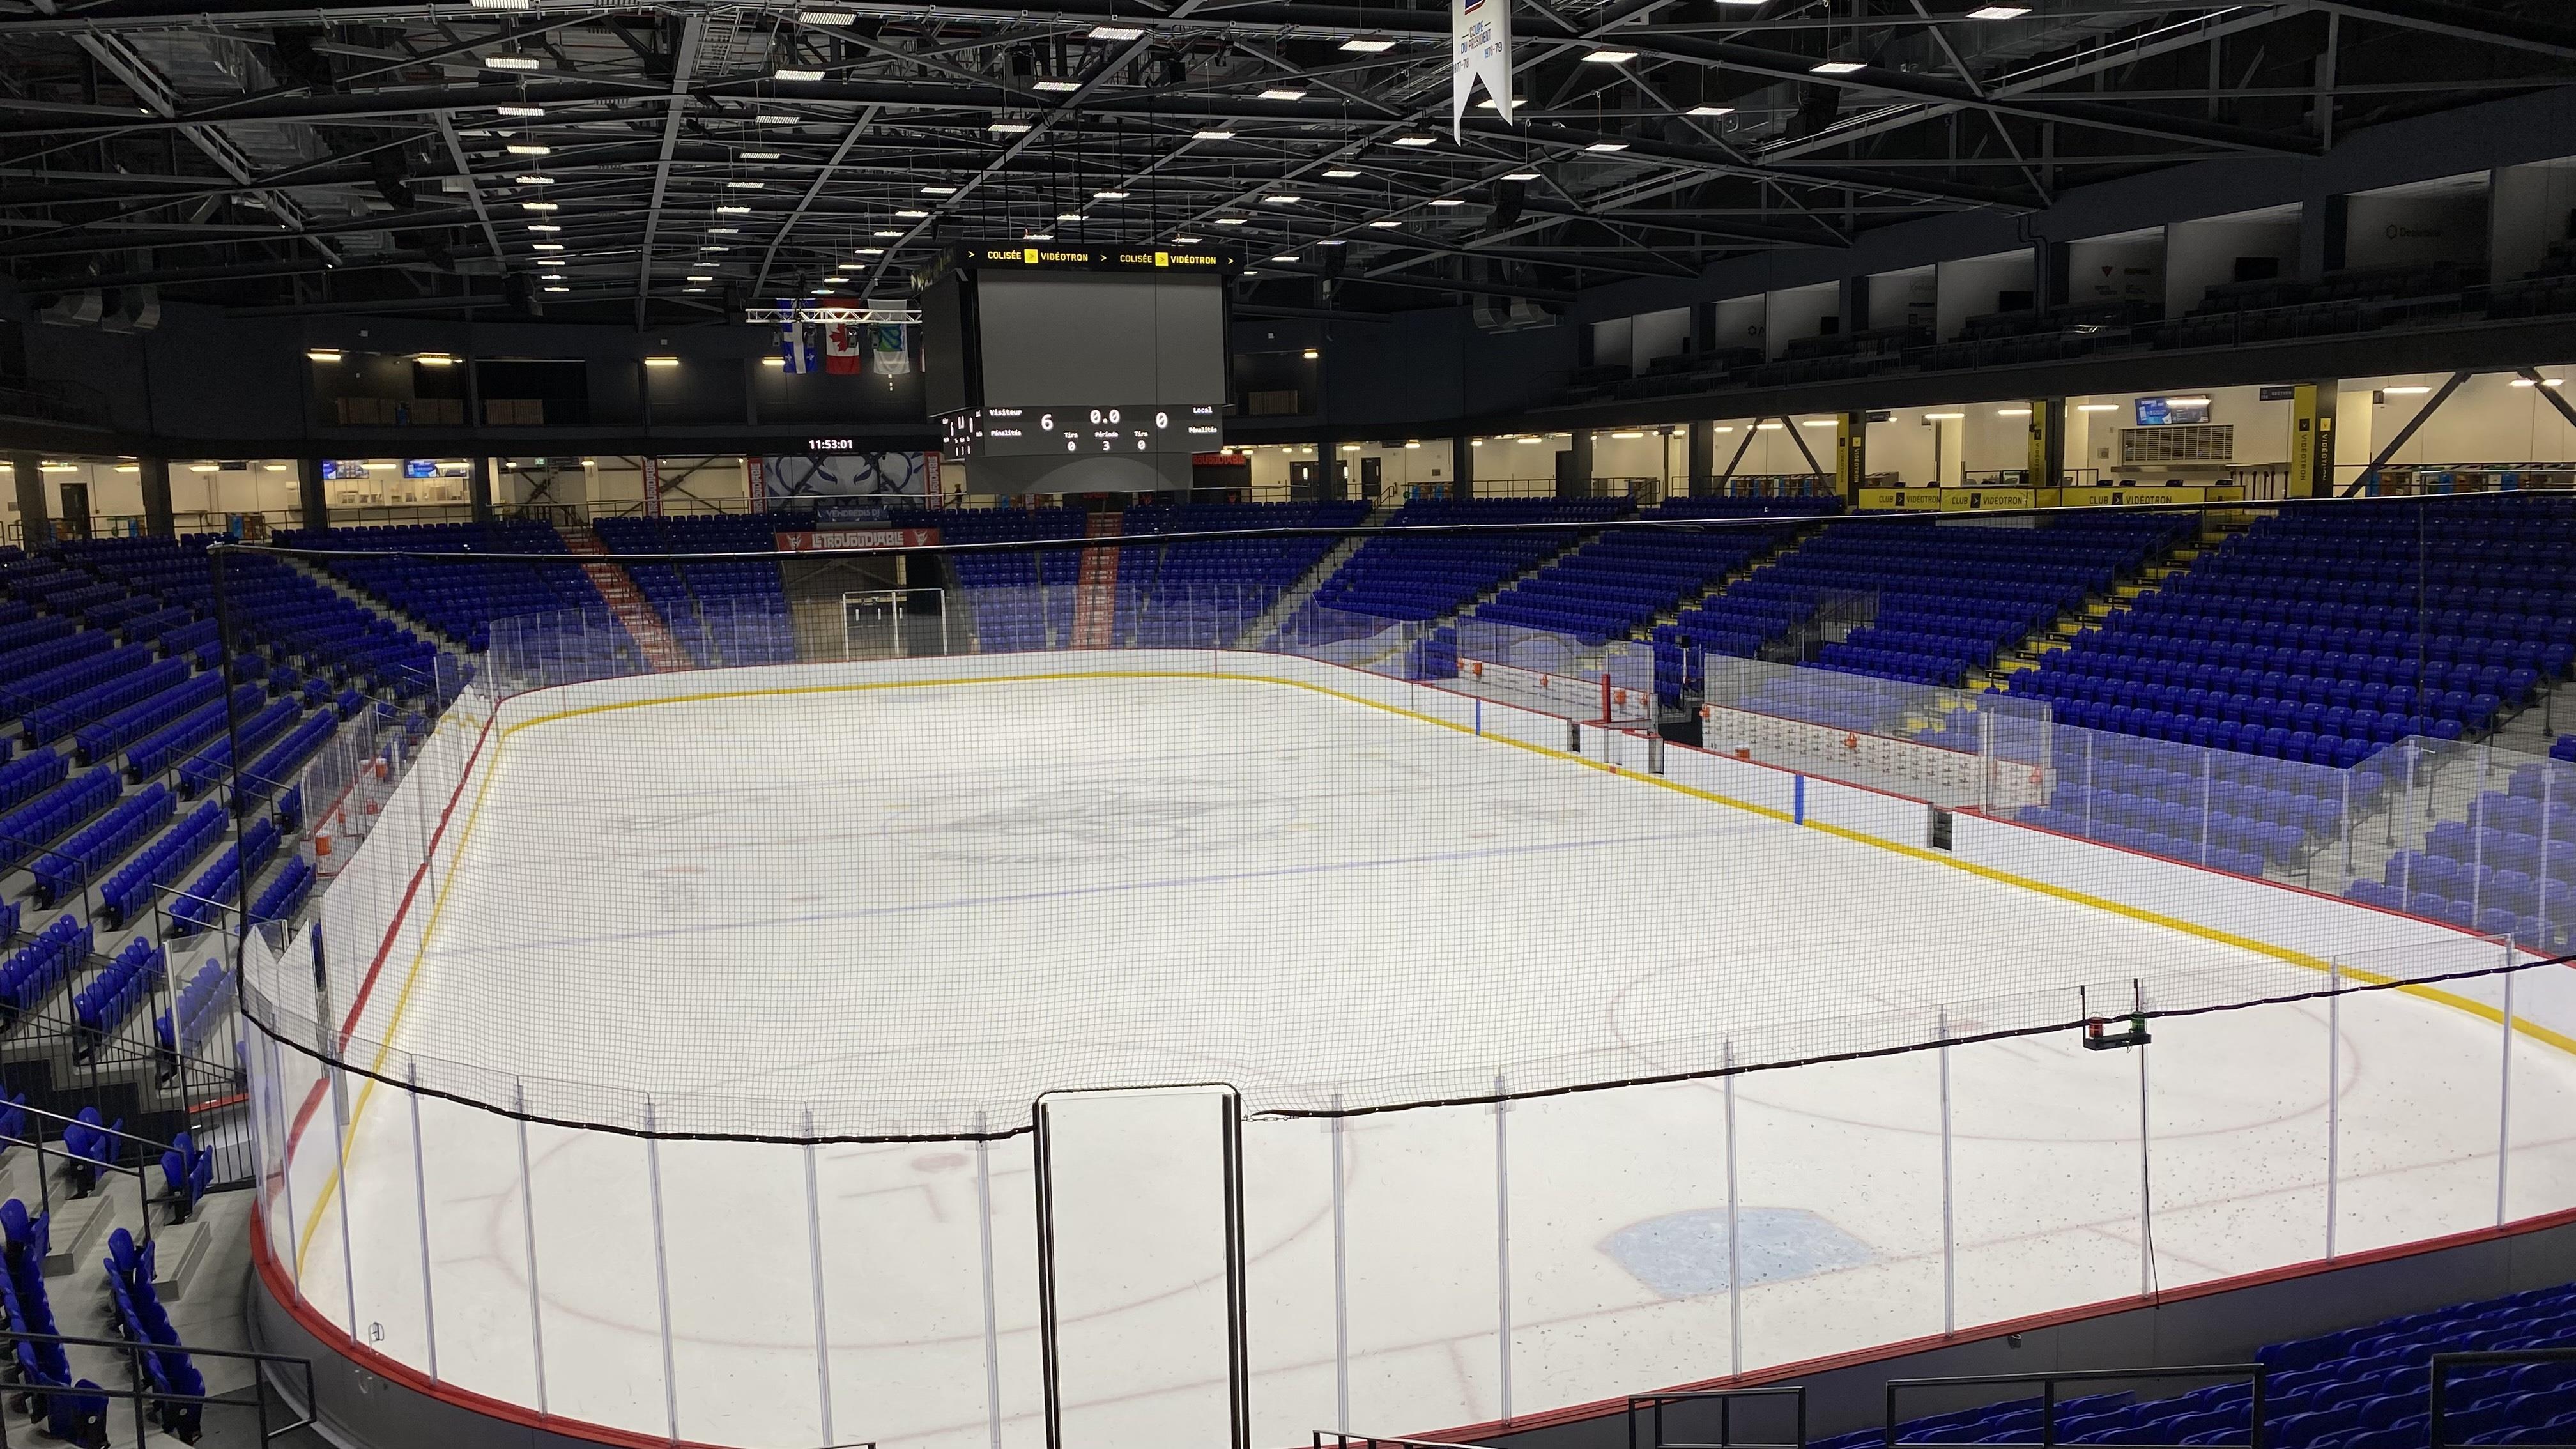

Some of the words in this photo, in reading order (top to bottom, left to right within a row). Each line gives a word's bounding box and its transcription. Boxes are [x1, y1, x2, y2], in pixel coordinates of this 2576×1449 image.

[1469, 20, 1483, 38] COUPE
[1460, 42, 1468, 54] DU
[1485, 42, 1502, 59] 1978-79
[1453, 57, 1469, 73] 977-78
[987, 250, 1022, 259] COLISÉE
[1041, 251, 1089, 261] VIDÉOTRON
[1120, 254, 1153, 263] COLISÉE
[1170, 255, 1216, 264] VIDÉOTRON
[1041, 413, 1054, 431] 6
[1090, 409, 1120, 424] 0.0
[1156, 412, 1168, 429] 0
[809, 440, 852, 449] 11:53:01
[1067, 441, 1077, 452] 0
[1103, 440, 1110, 451] 3
[1137, 440, 1146, 450] 0
[1952, 496, 1968, 505] CLUB
[1983, 494, 2023, 505] VIDÉOTRON
[2089, 496, 2108, 505] CLUB
[2126, 494, 2172, 505] VIDÉOTRON
[871, 509, 880, 518] DJ
